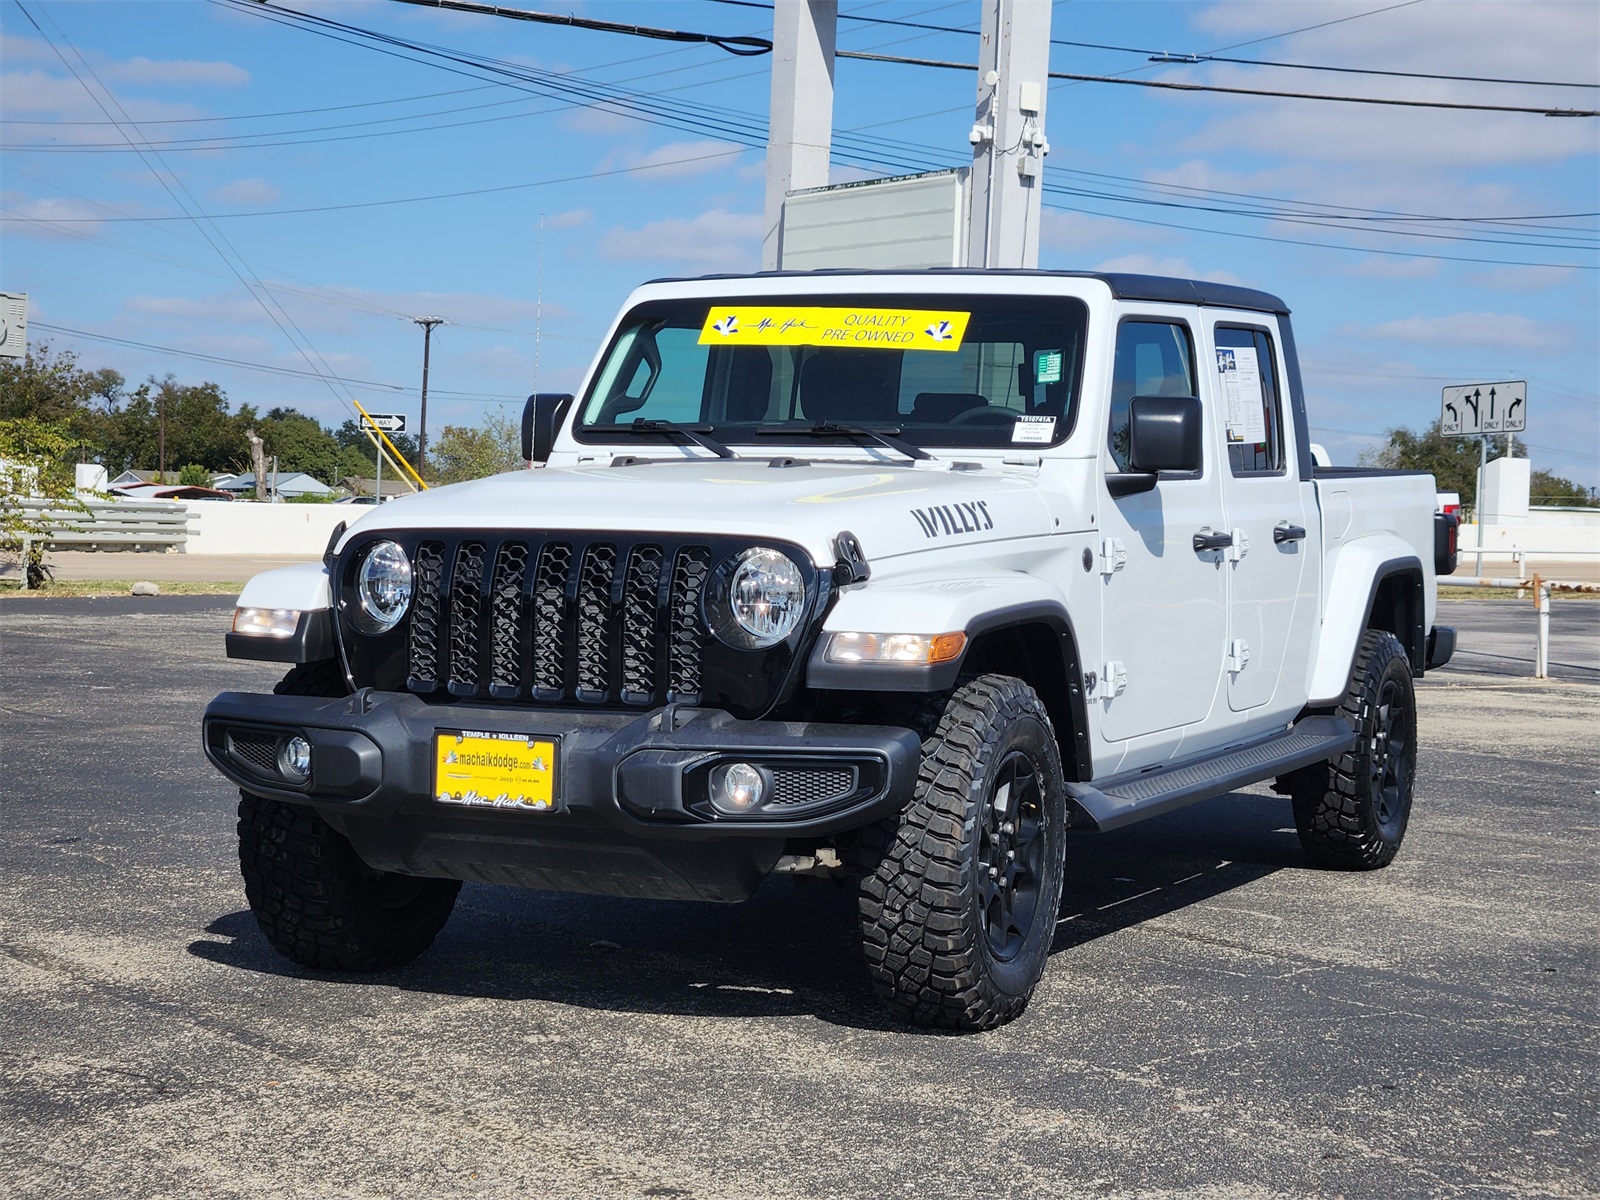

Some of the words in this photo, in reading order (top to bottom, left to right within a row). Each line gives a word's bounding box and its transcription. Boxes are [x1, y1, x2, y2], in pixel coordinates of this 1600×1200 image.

[744, 318, 778, 334] Mac
[844, 314, 911, 328] QUALITY
[821, 328, 915, 344] PRE-OWNED
[1443, 423, 1459, 432] ONLY
[1484, 421, 1500, 430] ONLY
[1505, 419, 1522, 428] ONLY
[909, 500, 993, 538] WILLYS
[461, 730, 491, 739] TEMPLE
[498, 733, 529, 742] KILLEEN
[459, 752, 531, 771] machaikdodge.com
[459, 789, 491, 805] Mac
[491, 793, 527, 808] Haik
